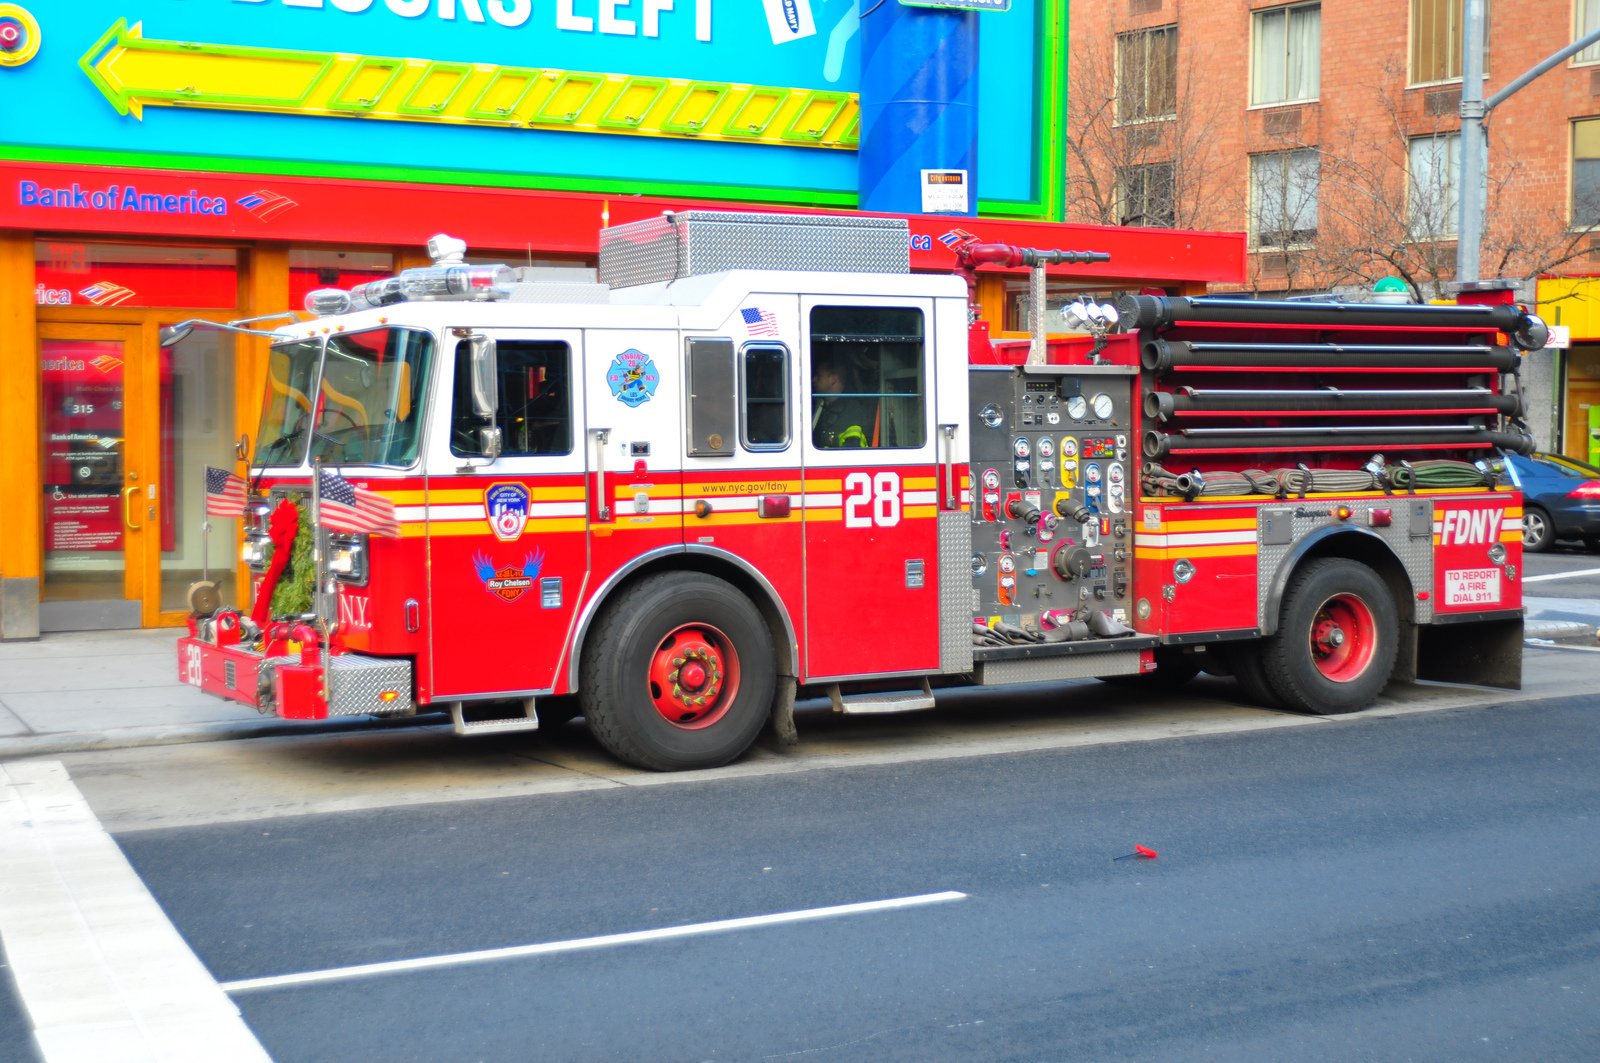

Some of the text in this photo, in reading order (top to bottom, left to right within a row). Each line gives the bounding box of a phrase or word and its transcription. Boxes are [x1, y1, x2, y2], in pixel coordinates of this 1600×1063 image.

[786, 7, 798, 28] NAVY
[20, 180, 227, 216] Bank of America
[621, 353, 645, 361] ENGINE
[72, 404, 94, 414] 315
[702, 481, 788, 493] www.nyc.gov/fdny
[845, 471, 900, 529] 28
[1441, 508, 1504, 545] FDNY
[1448, 570, 1497, 580] TO REPORT
[489, 579, 531, 588] Roy Chelsen
[1459, 582, 1486, 591] A FIRE
[502, 590, 520, 598] FDNY
[1453, 592, 1492, 603] DIAL 911
[341, 594, 372, 627] N.Y.
[188, 644, 202, 686] 28
